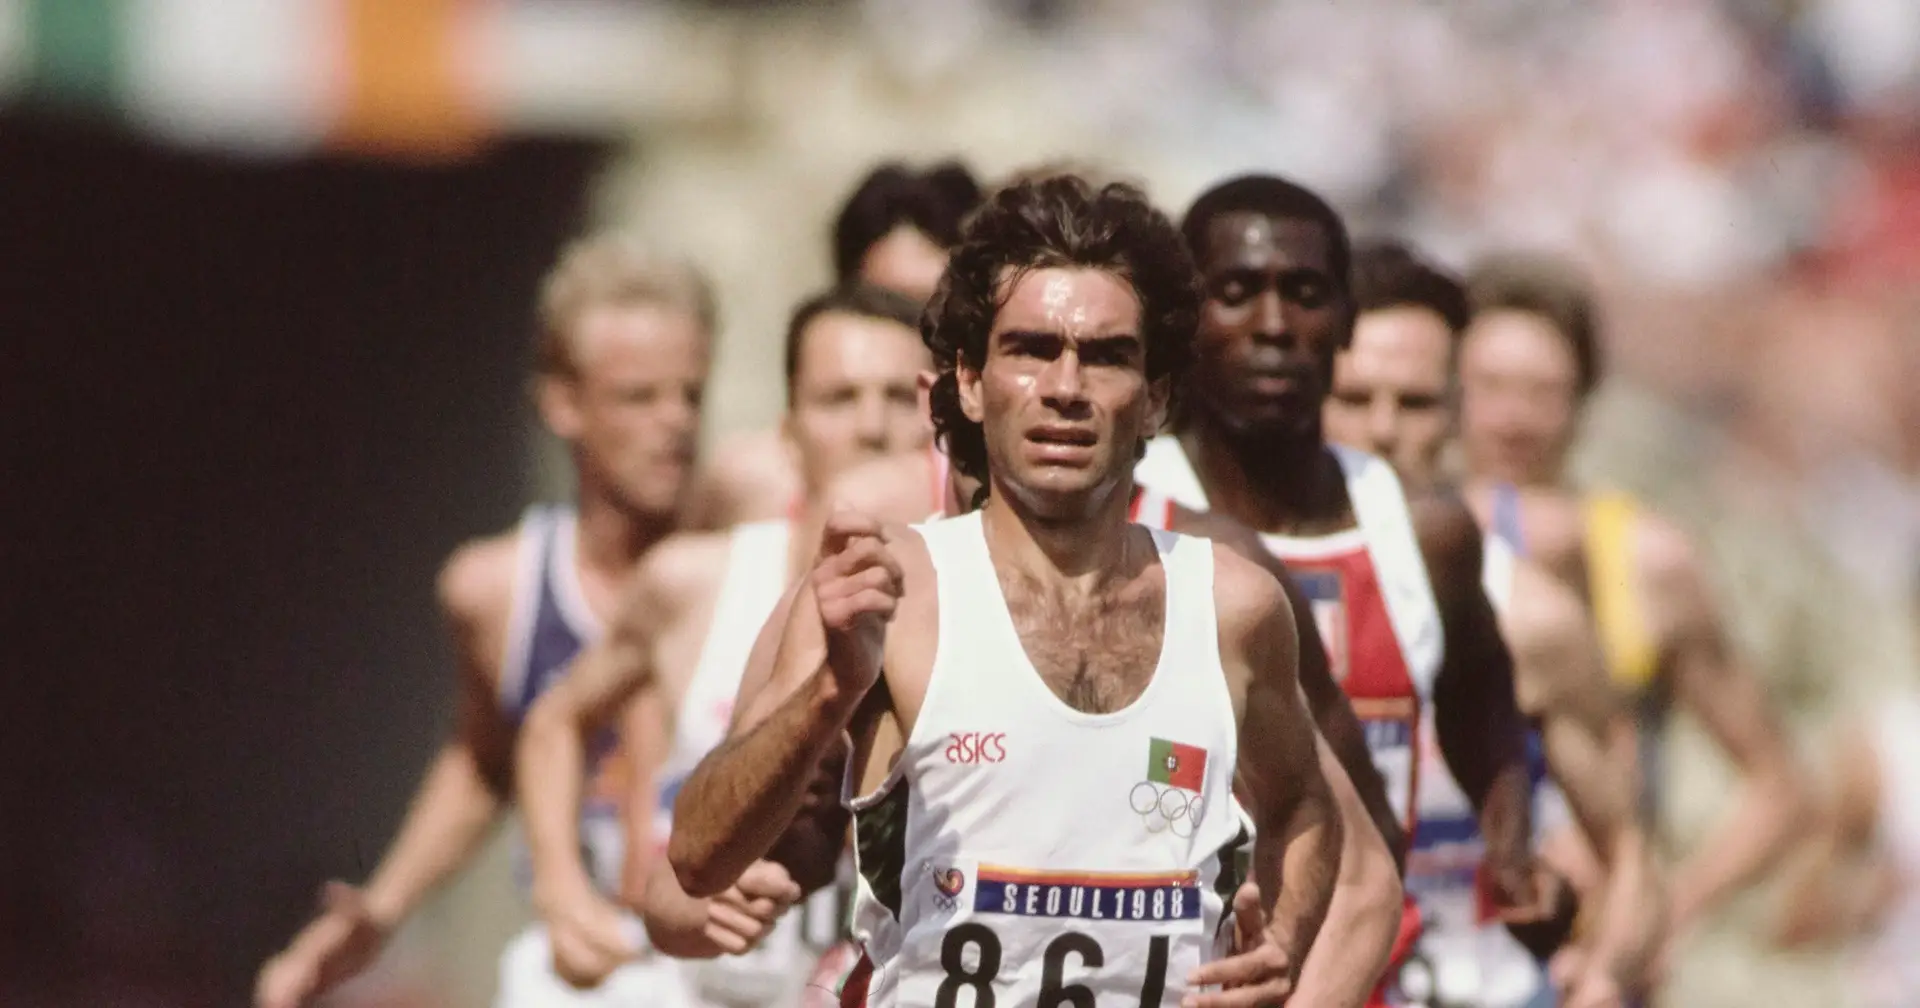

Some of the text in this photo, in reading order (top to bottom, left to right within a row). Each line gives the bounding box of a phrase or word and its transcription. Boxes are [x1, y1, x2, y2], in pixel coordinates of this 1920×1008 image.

[945, 732, 1006, 764] asics
[1003, 883, 1185, 920] SEOUL 1988
